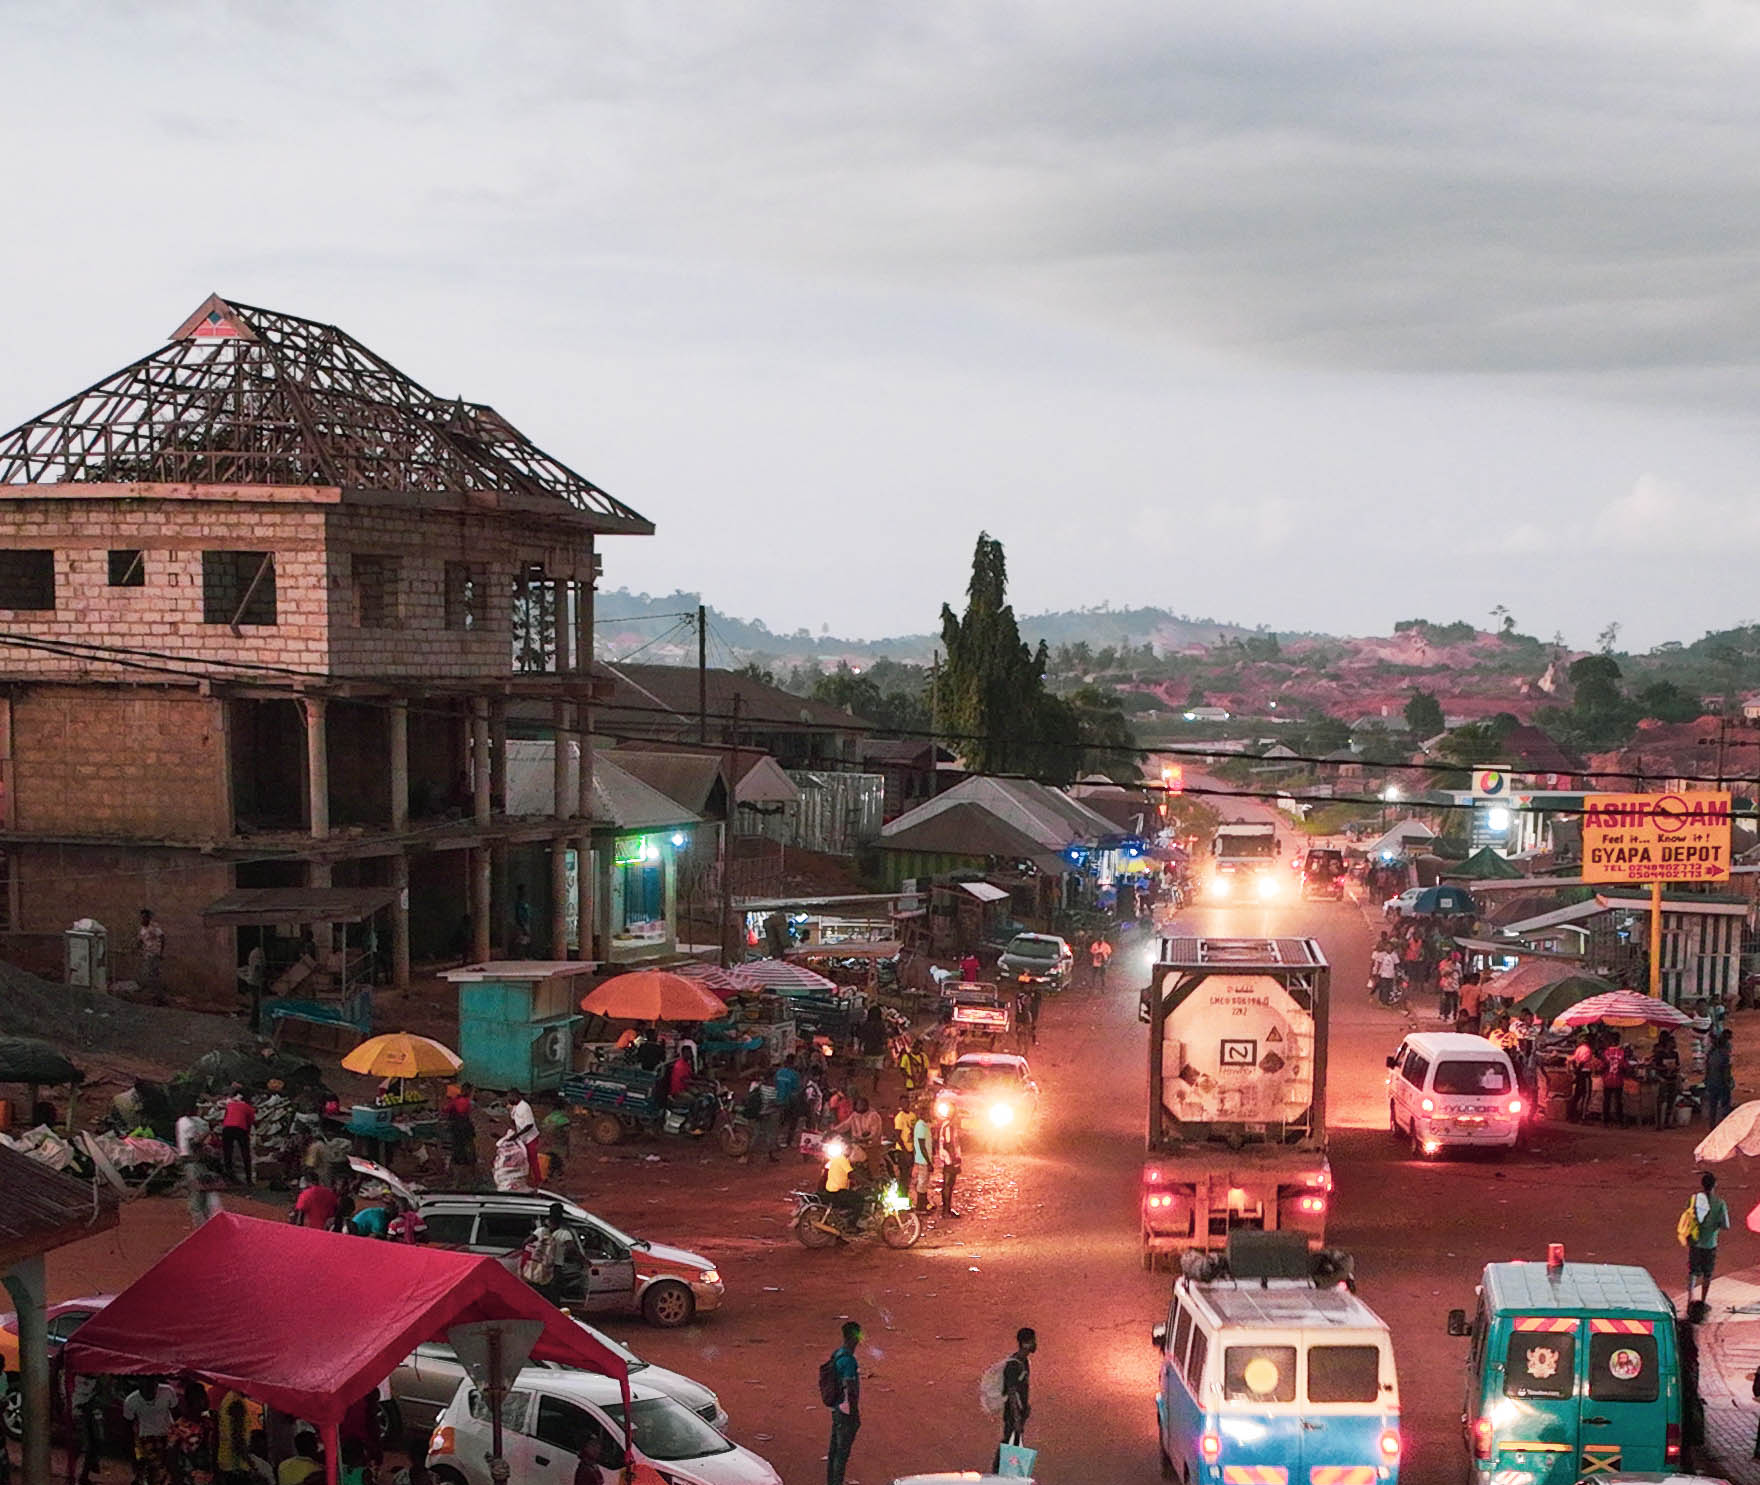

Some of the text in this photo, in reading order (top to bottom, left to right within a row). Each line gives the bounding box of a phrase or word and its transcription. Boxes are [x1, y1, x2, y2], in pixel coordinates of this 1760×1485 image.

[1602, 834, 1624, 844] Feel
[1657, 833, 1687, 843] Know
[1591, 846, 1722, 864] GYAPA DEPOT
